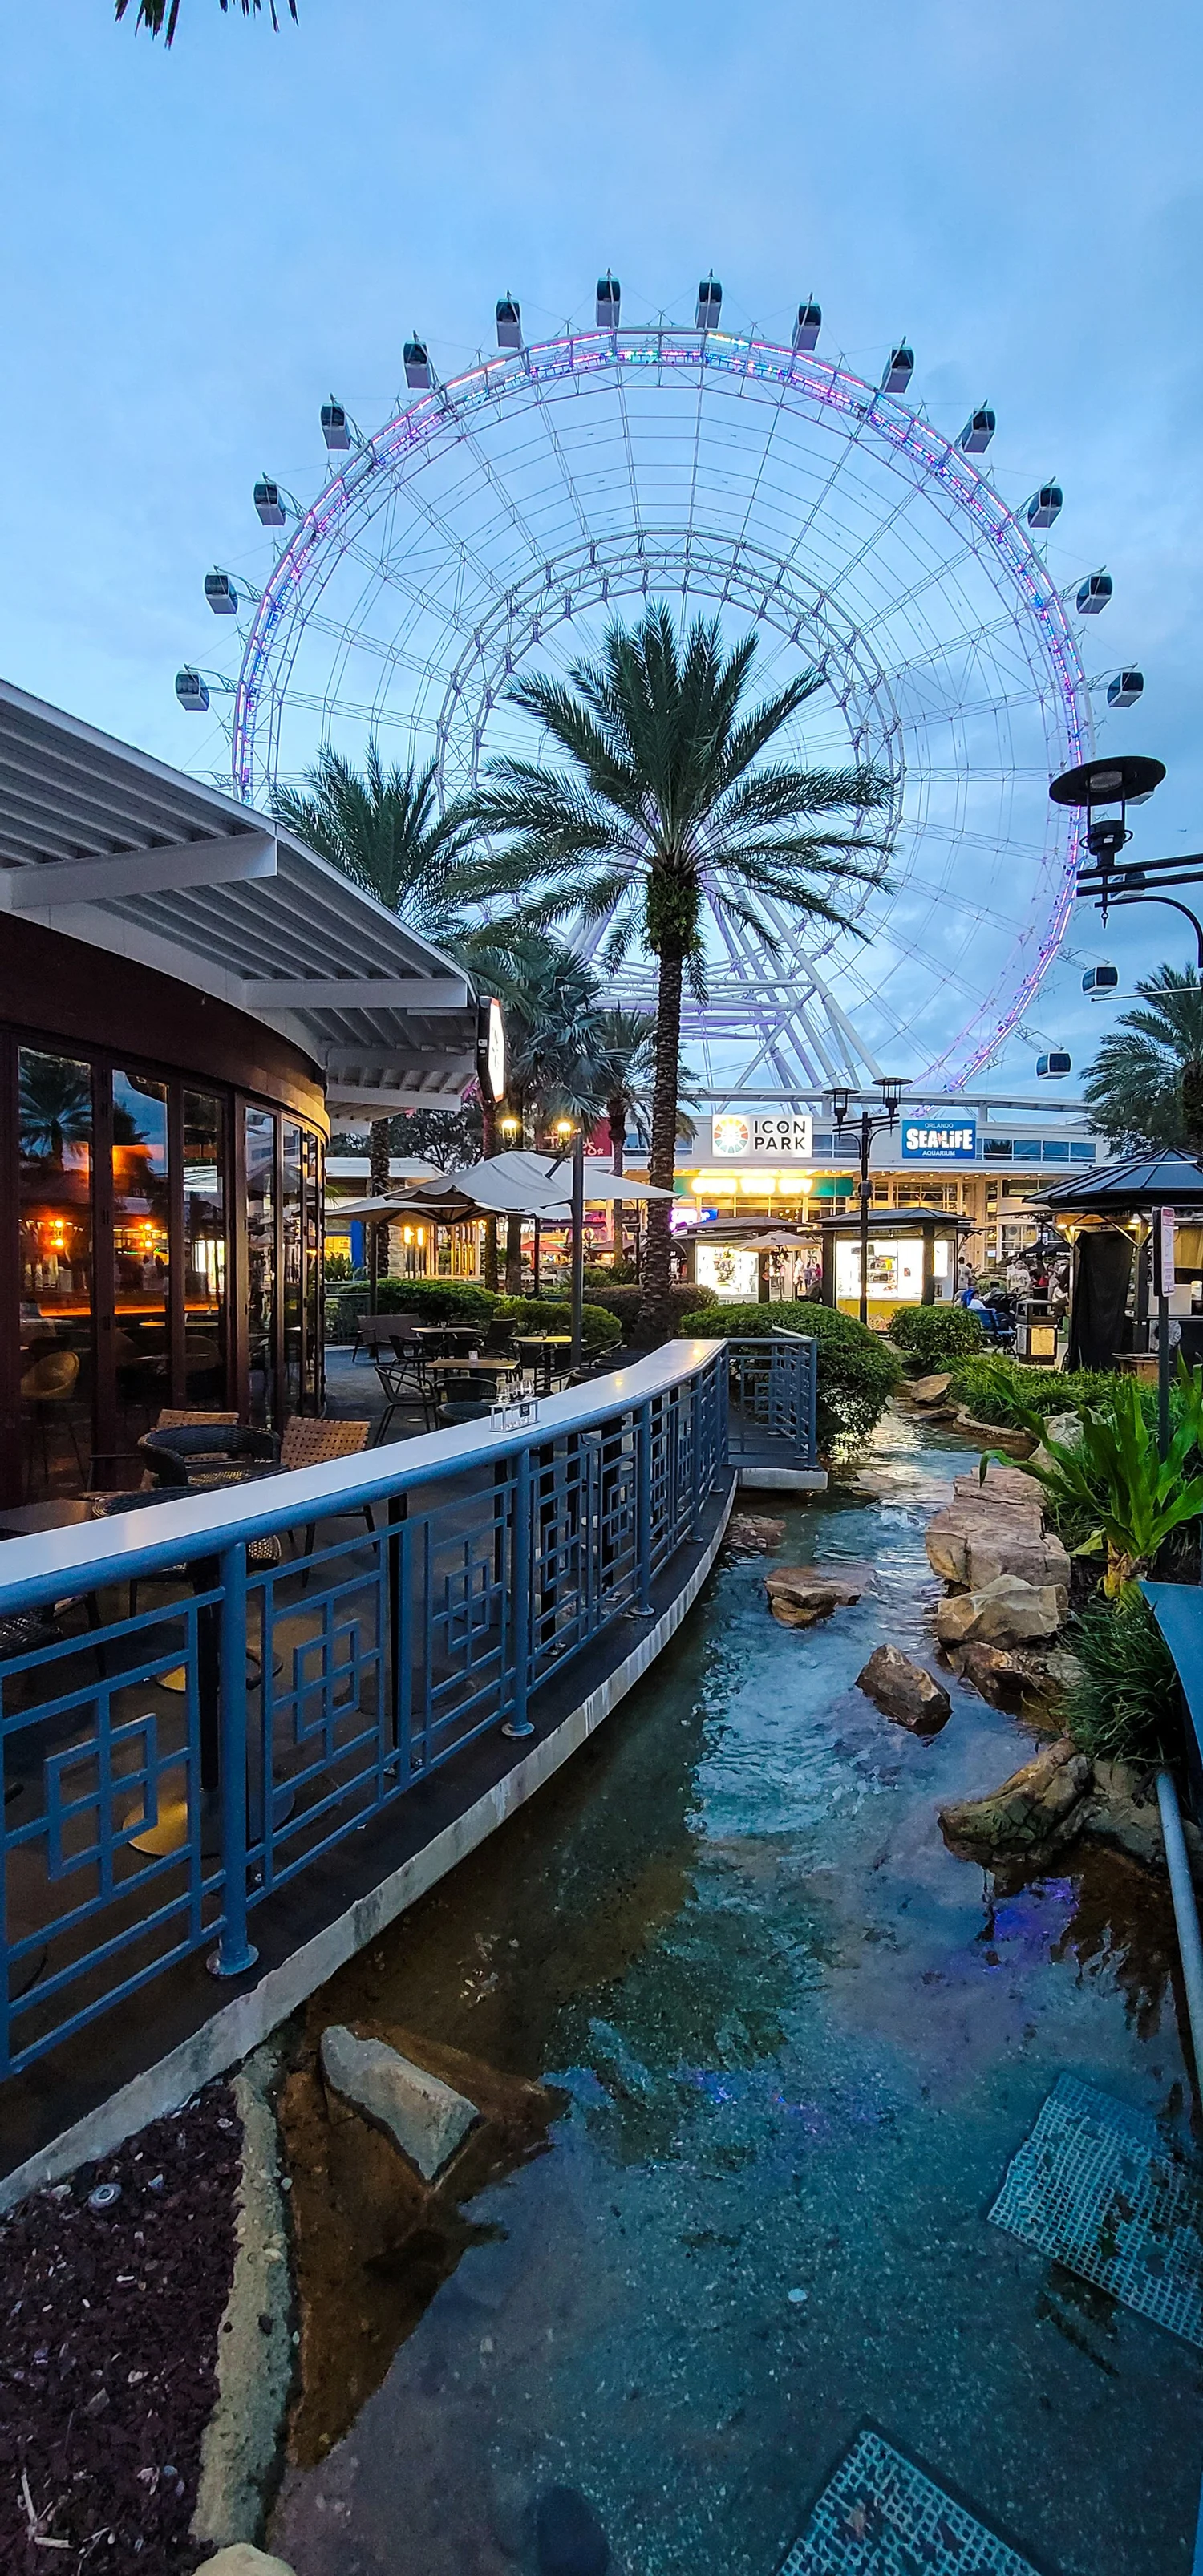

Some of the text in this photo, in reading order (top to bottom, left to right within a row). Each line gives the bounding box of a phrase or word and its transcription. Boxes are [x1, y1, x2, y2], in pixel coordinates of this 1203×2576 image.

[754, 1120, 806, 1134] ICON
[754, 1136, 806, 1150] PARK
[906, 1128, 939, 1150] SEA
